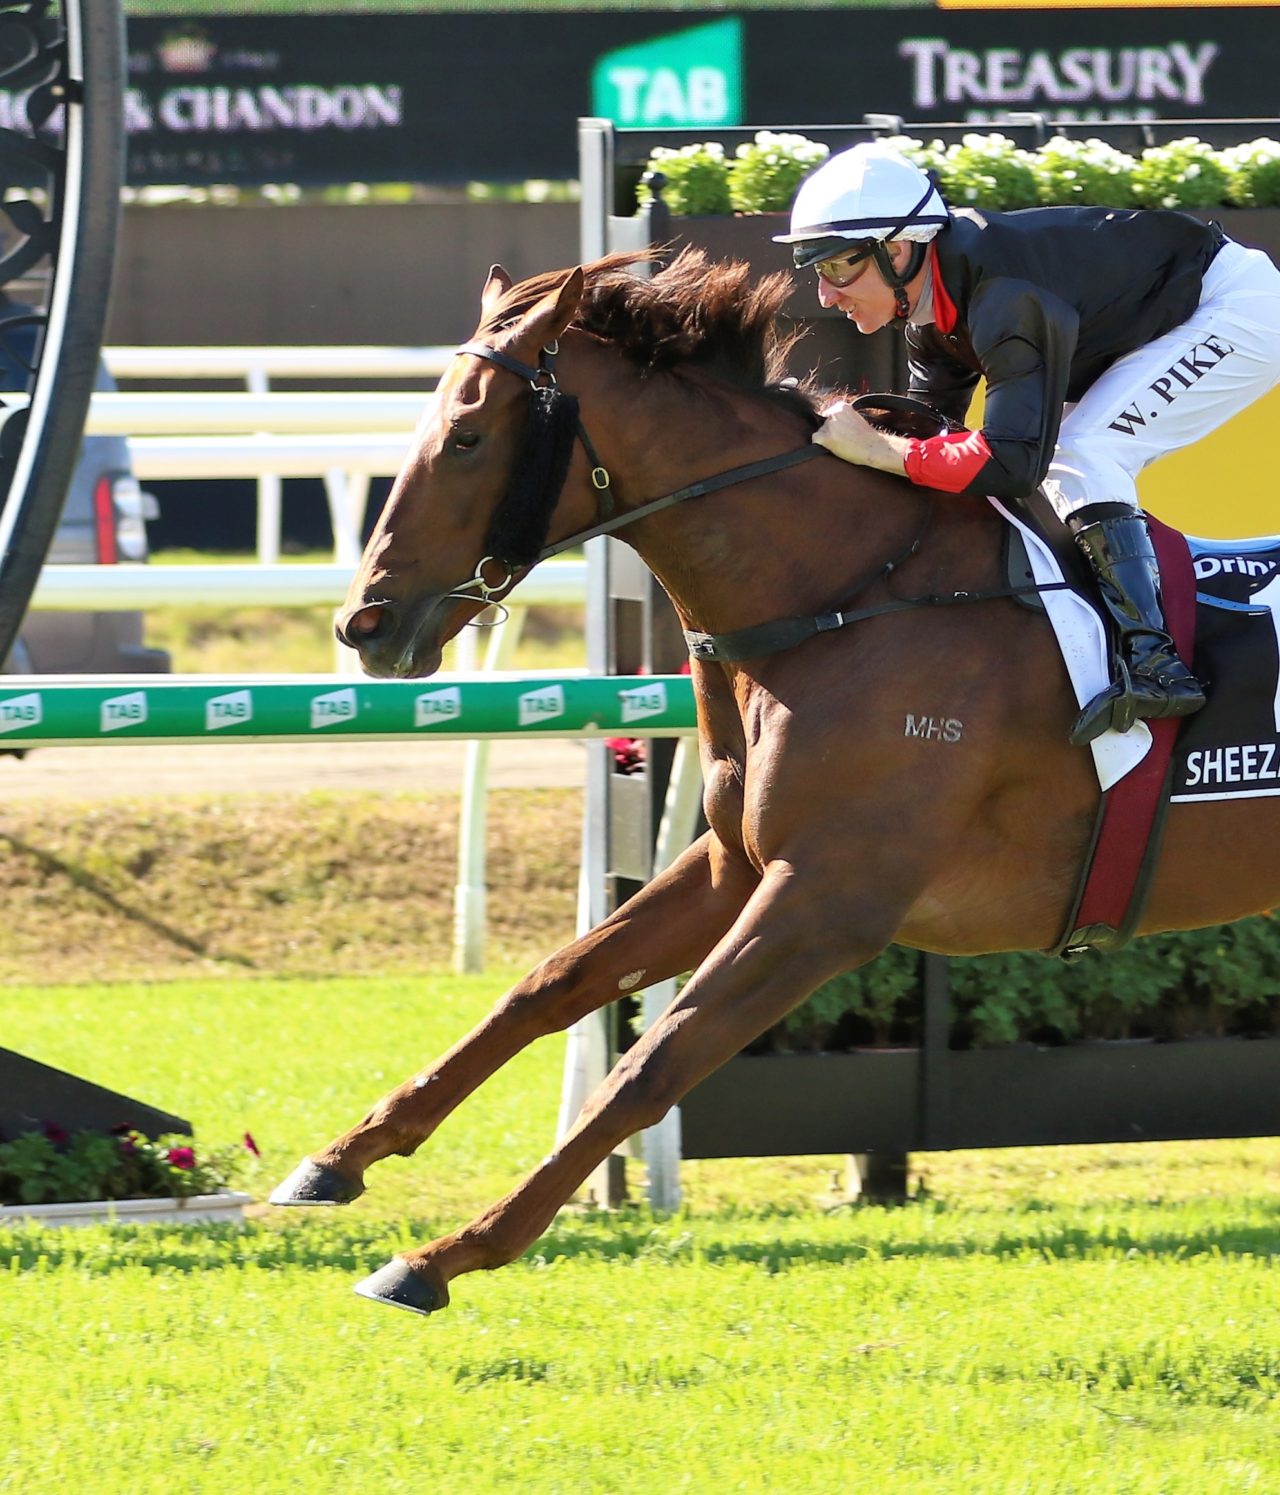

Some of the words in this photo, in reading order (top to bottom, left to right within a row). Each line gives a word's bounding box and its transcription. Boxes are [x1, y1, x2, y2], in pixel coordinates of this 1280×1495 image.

[899, 37, 1219, 108] TREASURY
[608, 66, 728, 123] TAB
[158, 83, 402, 131] CHANDON
[1107, 401, 1158, 436] W.
[1148, 334, 1235, 406] PIKE
[212, 702, 246, 718] TAB
[317, 701, 350, 716] TAB
[421, 699, 455, 714] TAB
[523, 697, 557, 713] TAB
[628, 695, 662, 711] TAB
[1, 705, 36, 721] TAB
[107, 704, 140, 720] TAB
[904, 713, 963, 743] MHS
